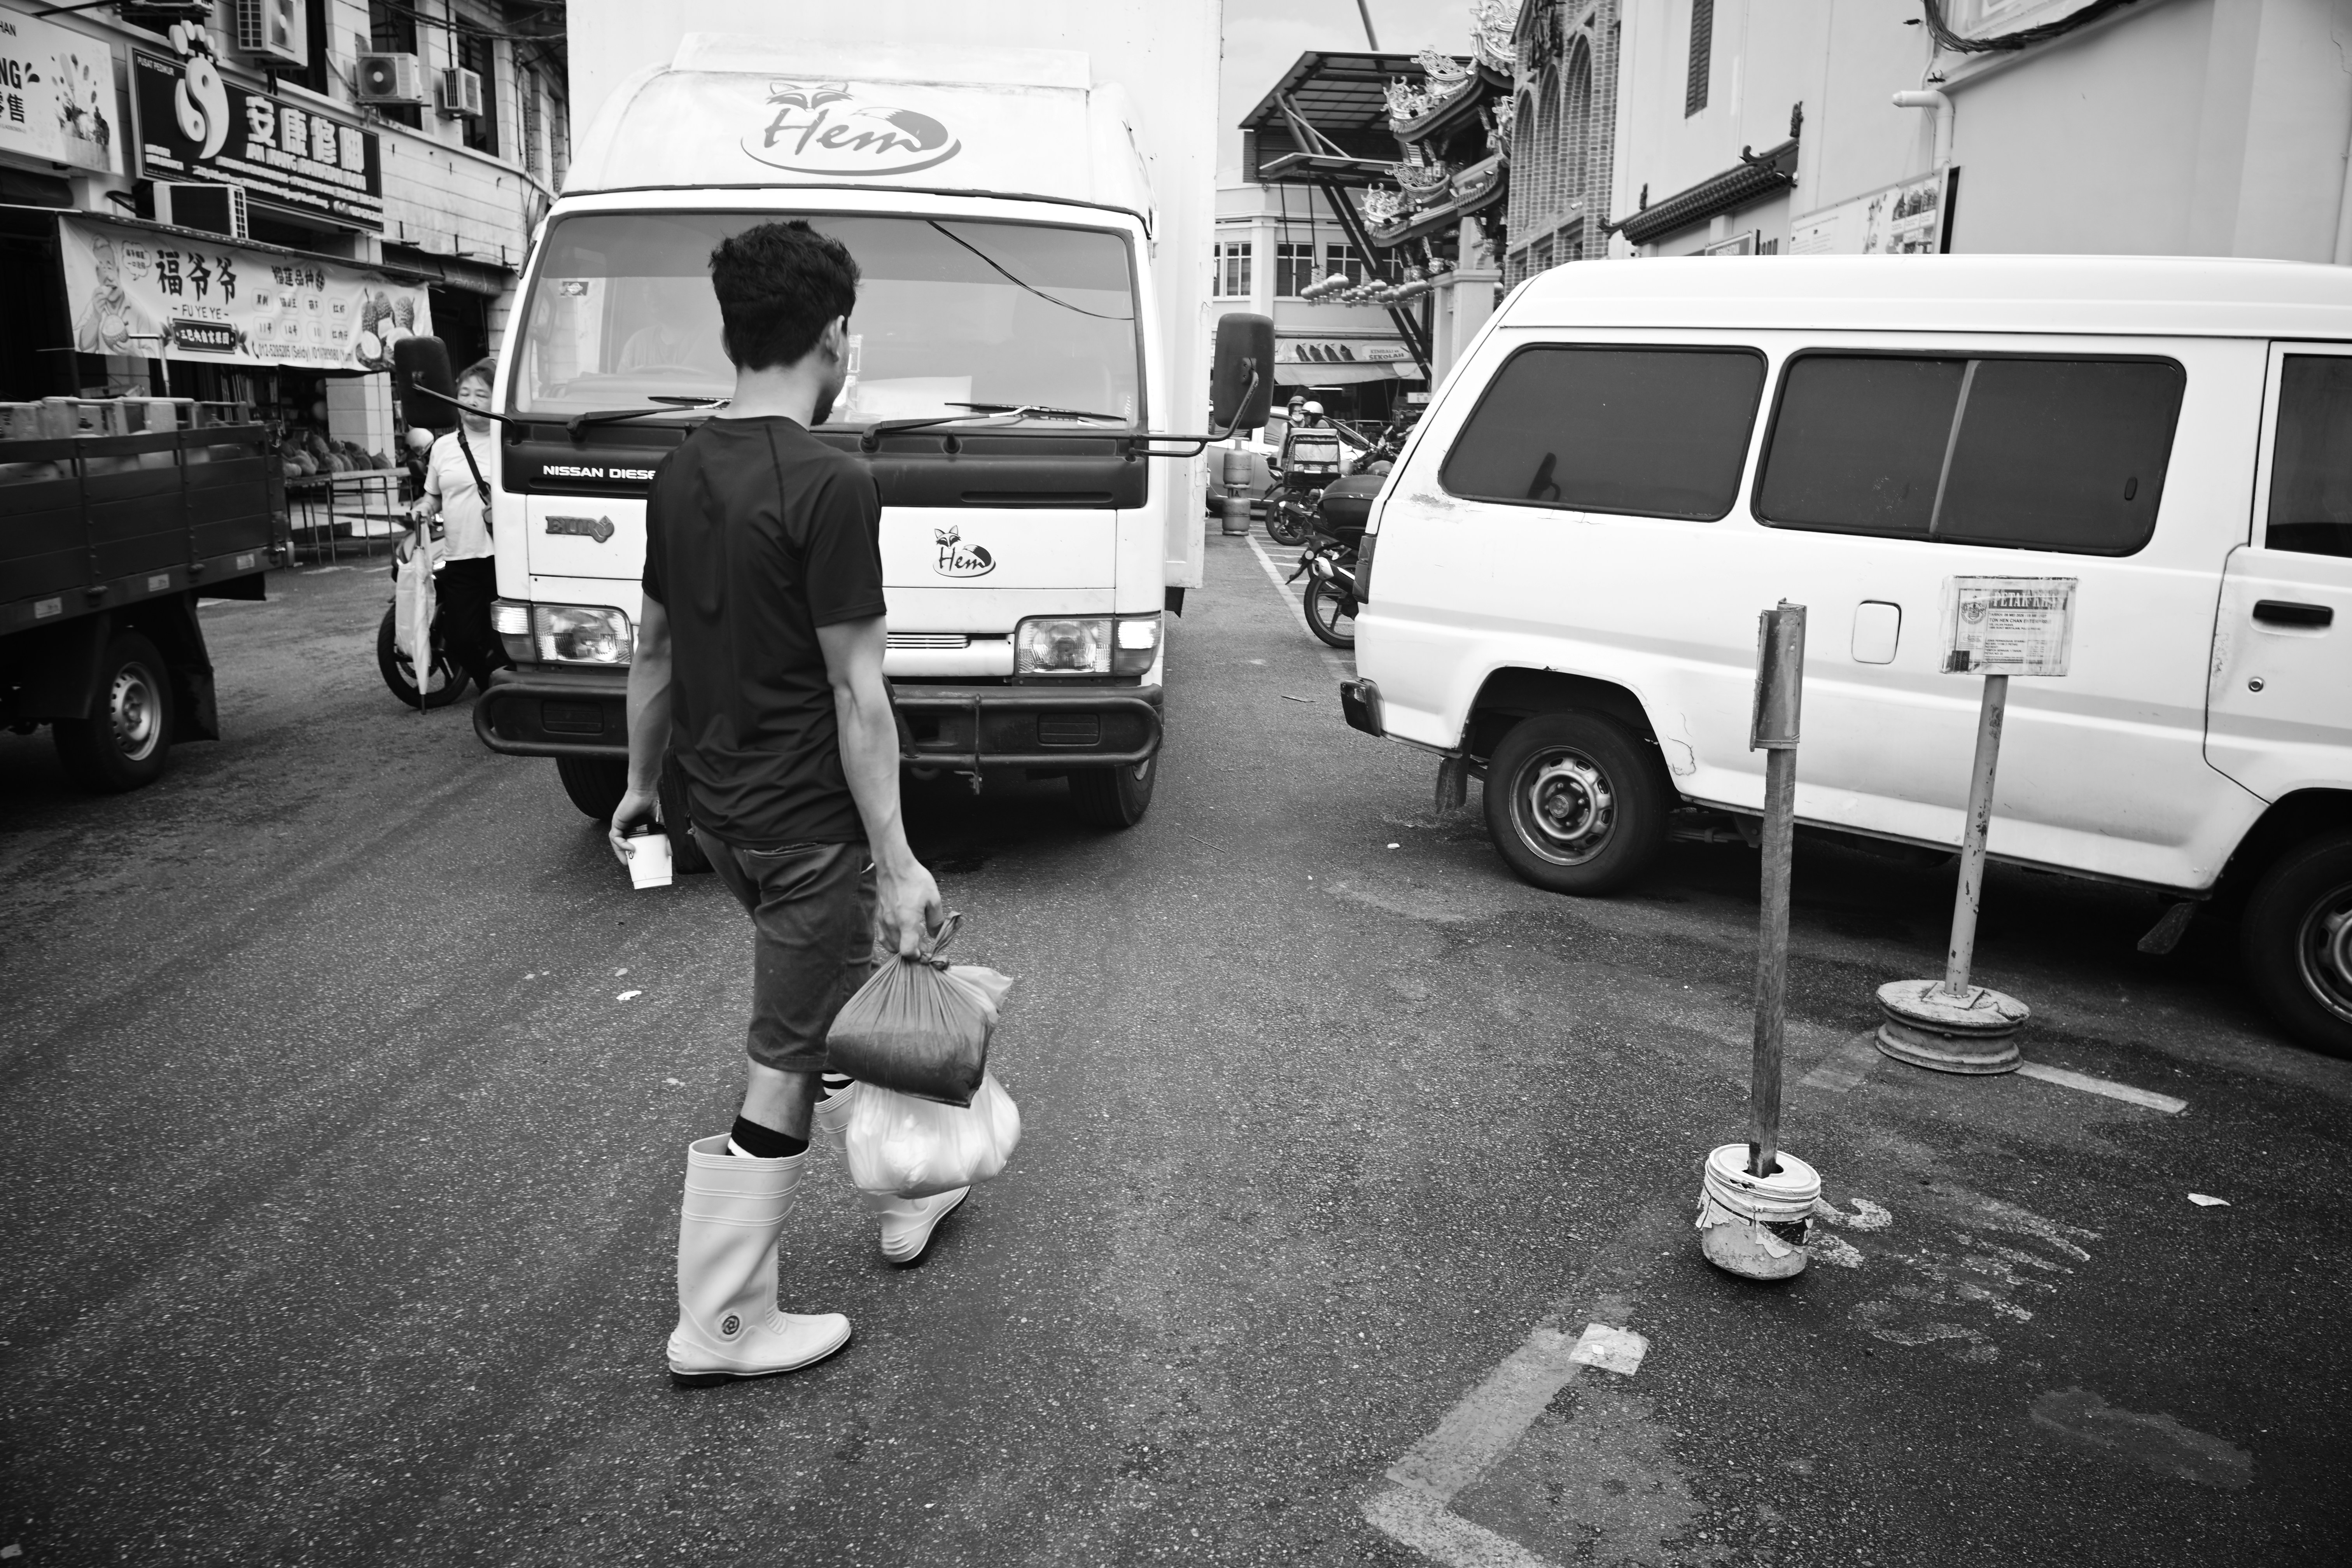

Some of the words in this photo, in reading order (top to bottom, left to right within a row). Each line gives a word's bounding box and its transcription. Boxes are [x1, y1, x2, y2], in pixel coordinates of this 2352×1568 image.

[0, 91, 24, 124] 售
[246, 143, 265, 163] AN
[266, 148, 297, 171] KANG
[156, 250, 236, 305] 福爷爷
[182, 304, 193, 317] FU
[196, 306, 207, 318] YE
[210, 307, 222, 319] YE
[543, 466, 603, 478] NISSAN
[609, 468, 656, 480] DIESE
[1993, 592, 2031, 607] PETAK
